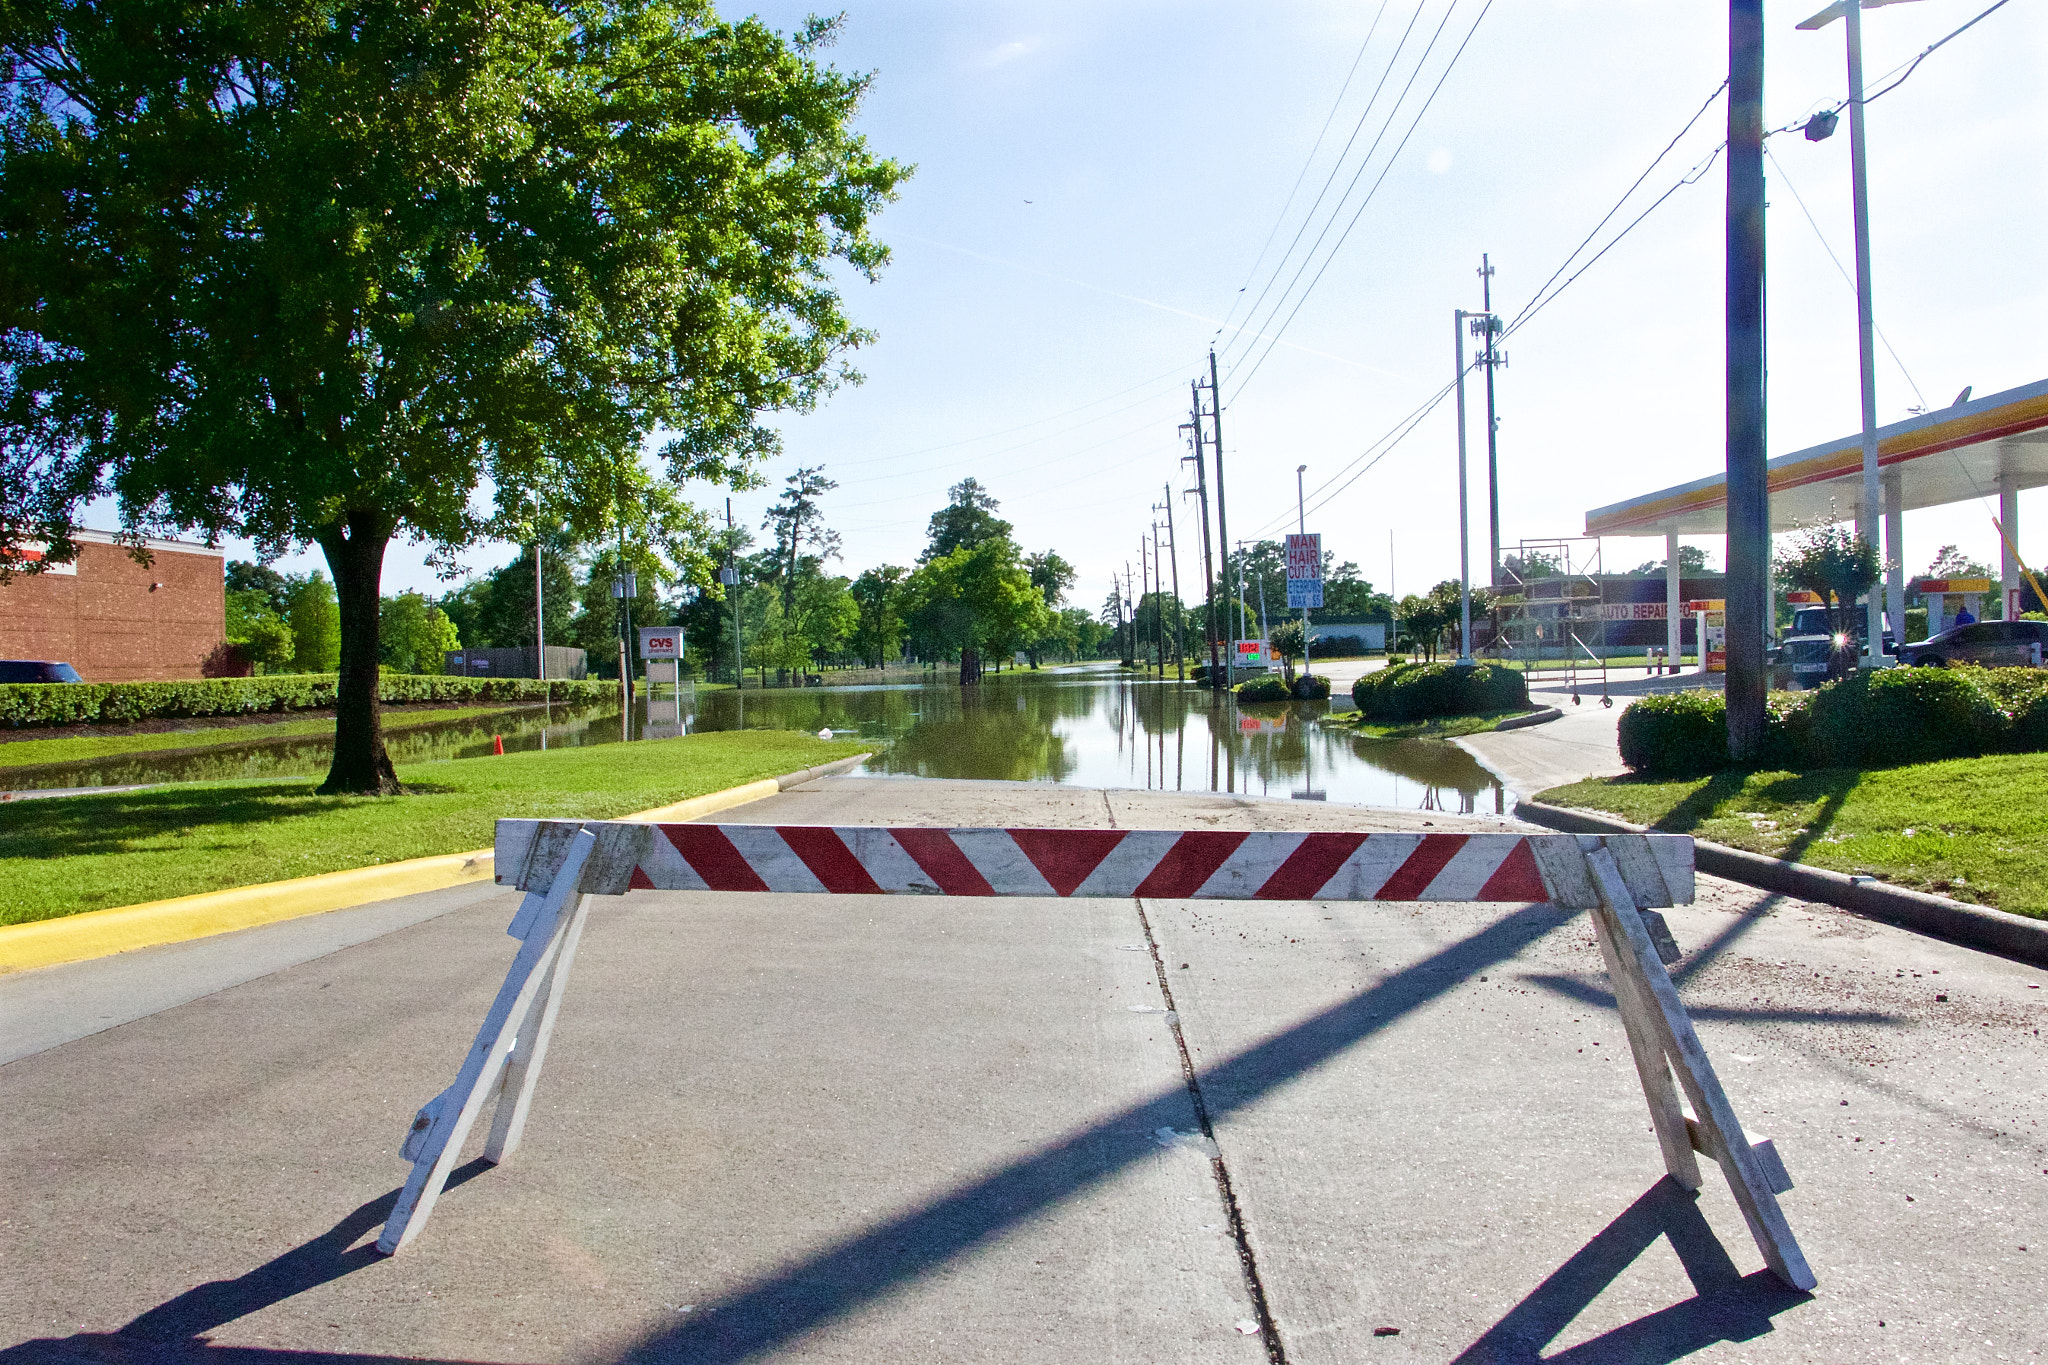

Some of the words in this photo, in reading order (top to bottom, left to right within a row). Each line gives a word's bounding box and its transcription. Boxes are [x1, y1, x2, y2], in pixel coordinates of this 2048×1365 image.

[1290, 535, 1317, 549] MAN
[1289, 550, 1318, 564] HAIR
[1311, 564, 1320, 579] $7
[1288, 579, 1321, 594] EYEBROWS
[1312, 594, 1320, 607] $5
[1602, 604, 1628, 618] AUTO
[649, 638, 673, 648] CVS
